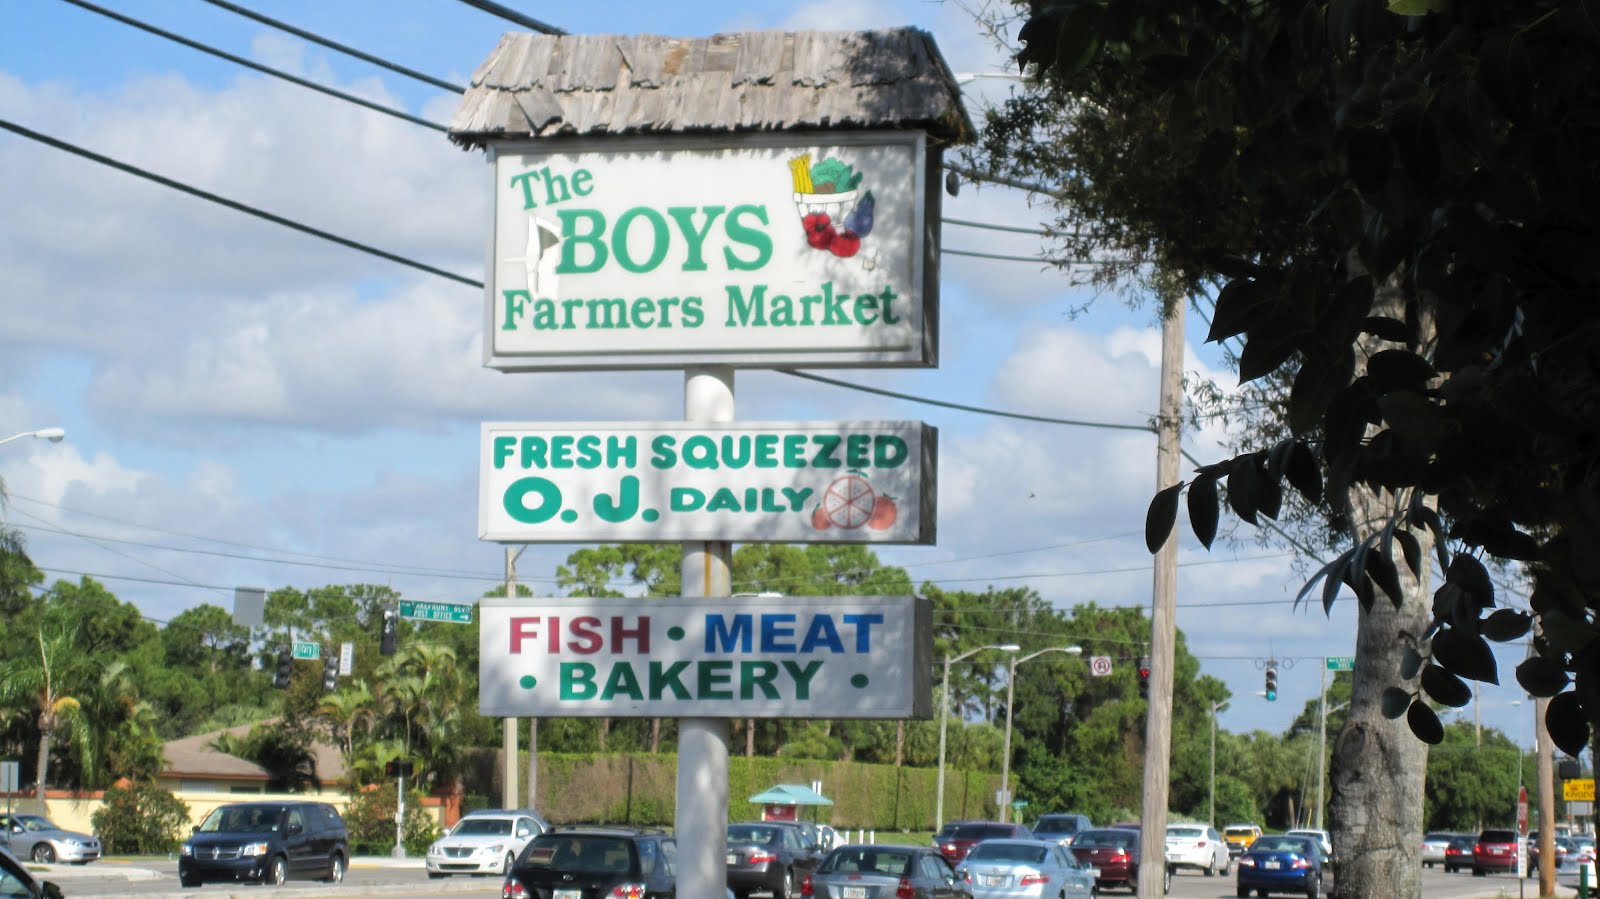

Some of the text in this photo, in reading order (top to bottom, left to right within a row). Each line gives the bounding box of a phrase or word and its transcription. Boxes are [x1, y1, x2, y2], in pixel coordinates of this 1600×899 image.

[511, 167, 593, 210] The
[556, 204, 773, 274] BOYS
[502, 290, 704, 330] Farmers
[725, 281, 899, 327] Market
[493, 434, 908, 470] FRESH SQUEEZED
[503, 475, 814, 524] O. J. DAILY
[413, 610, 453, 620] POST OFFICE
[509, 613, 884, 655] FISH MEAT
[559, 661, 824, 701] BAKERY
